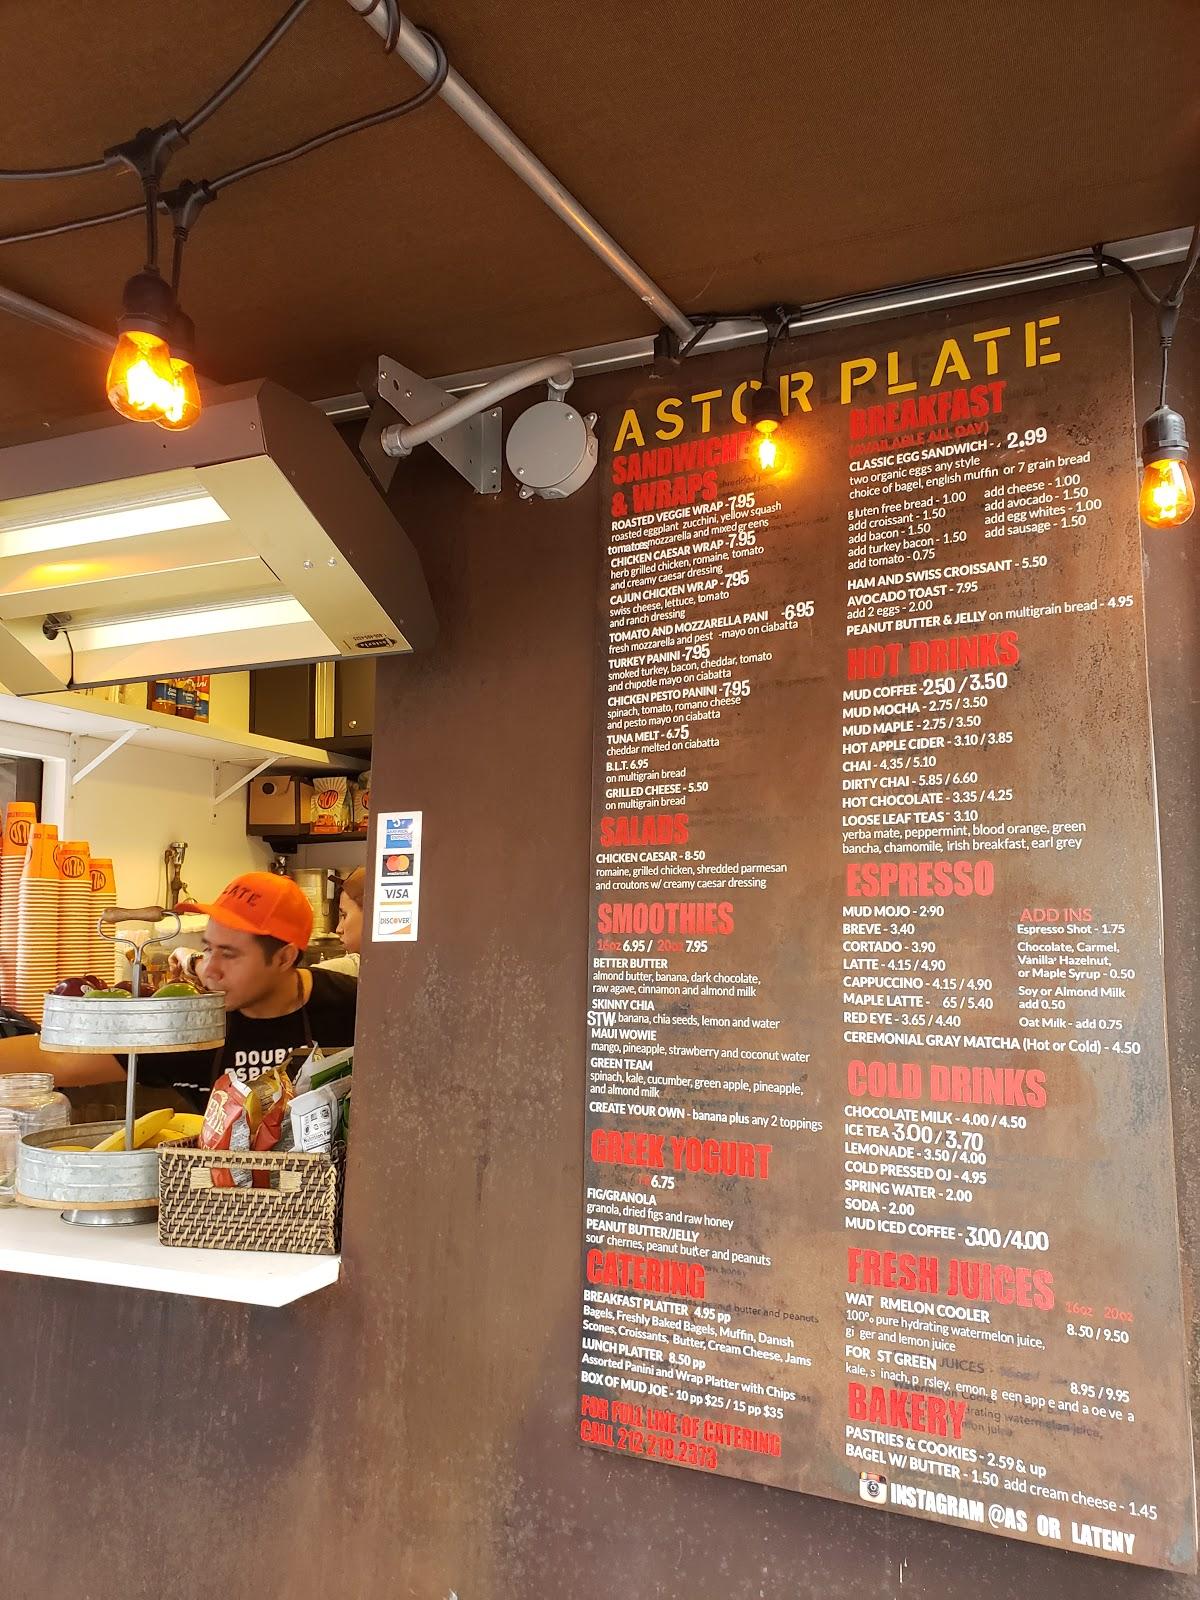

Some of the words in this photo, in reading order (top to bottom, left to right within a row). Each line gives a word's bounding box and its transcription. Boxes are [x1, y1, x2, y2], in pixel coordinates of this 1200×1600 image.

[840, 316, 1060, 404] PLATE
[850, 380, 1008, 440] BREAKFAST
[850, 455, 894, 472] CLASSIC
[896, 451, 919, 464] EGG
[921, 440, 987, 460] SANDWICH
[1007, 427, 1047, 449] 2.99
[612, 492, 627, 517] &
[633, 471, 717, 514] WRAPS
[611, 515, 654, 531] ROASTED
[656, 510, 690, 525] VEGGIE
[693, 501, 723, 516] WRAP
[611, 528, 642, 542] roasted
[644, 523, 678, 539] eggplant
[683, 515, 719, 529] zucchini,
[720, 510, 750, 524] yellow
[751, 501, 781, 517] squash
[611, 554, 652, 568] CHICKEN
[653, 546, 690, 560] CAESAR
[693, 540, 723, 553] WRAP
[848, 574, 875, 590] HAM
[878, 572, 904, 584] AND
[905, 569, 941, 582] SWISS
[944, 560, 1012, 577] CROISSANT
[1021, 556, 1047, 569] 5.50
[847, 591, 906, 607] AVOCADO
[908, 585, 946, 600] TOAST
[957, 581, 978, 593] 7.95
[847, 620, 893, 636] PEANUT
[896, 615, 941, 630] BUTTER
[943, 615, 952, 625] &
[954, 611, 987, 624] JELLY
[989, 610, 1003, 620] on
[1006, 601, 1061, 620] multigrain
[1064, 593, 1097, 612] bread
[610, 628, 650, 642] TOMATO
[651, 626, 673, 637] AND
[675, 615, 742, 633] MOZZARELLA
[608, 669, 639, 681] smoked
[641, 665, 669, 679] turkey,
[671, 661, 699, 673] bacon,
[701, 657, 738, 669] cheddar,
[740, 652, 772, 664] tomato
[609, 654, 646, 669] TURKEY
[647, 651, 680, 664] PANINI
[847, 643, 903, 681] HOT
[909, 631, 1020, 674] DRINKS
[843, 689, 871, 701] MUD
[873, 685, 917, 698] COFFEE
[607, 733, 634, 744] TUNA
[635, 730, 659, 742] MELT
[843, 743, 868, 755] HOT
[870, 740, 906, 752] APPLE
[909, 737, 944, 750] CIDER
[630, 759, 648, 769] 6.95
[606, 786, 643, 799] GRILLED
[645, 784, 681, 796] CHEESE
[688, 782, 708, 793] 5.50
[843, 778, 878, 790] DIRTY
[880, 776, 909, 788] CHAI
[843, 796, 868, 808] HOT
[870, 793, 943, 807] CHOCOLATE
[843, 815, 880, 826] LOOSE
[883, 813, 912, 825] LEAF
[914, 812, 944, 823] TEAS
[953, 810, 977, 821] 3.10
[601, 813, 689, 847] SALADS
[846, 861, 994, 897] ESPRESSO
[386, 888, 408, 898] VISA
[597, 902, 734, 935] SMOOTHIES
[1020, 908, 1059, 922] ADD
[1064, 909, 1092, 922] INS
[843, 924, 881, 935] BREVE
[1018, 924, 1064, 935] Espresso
[1067, 924, 1092, 934] Shot
[1102, 924, 1125, 934] 1.75
[623, 940, 645, 951] 6.95
[686, 940, 707, 952] 7.95
[843, 941, 902, 953] CORTADO
[594, 958, 628, 968] BETTER
[630, 959, 667, 969] BUTTER
[593, 971, 624, 980] almond
[626, 972, 654, 983] butter,
[656, 973, 689, 983] banana,
[691, 972, 711, 982] dark
[713, 973, 760, 985] chocolate,
[844, 977, 923, 989] CAPPUCCINO
[592, 999, 629, 1010] SKINNY
[630, 1000, 654, 1010] CHIA
[592, 1028, 618, 1039] MAUI
[619, 1029, 656, 1040] WOWIE
[844, 1031, 924, 1047] CEREMONIAL
[926, 1034, 961, 1047] GRAY
[963, 1036, 1020, 1050] MATCHA
[1023, 1039, 1050, 1052] (Hot
[1053, 1042, 1066, 1052] or
[1069, 1040, 1101, 1054] Cold)
[591, 1058, 623, 1069] GREEN
[624, 1059, 652, 1070] TEAM
[848, 1060, 922, 1100] COLD
[930, 1065, 1047, 1109] DRINKS
[590, 1101, 626, 1114] CREATE
[628, 1104, 656, 1117] YOUR
[659, 1108, 685, 1119] OWN
[591, 1129, 664, 1169] GREEK
[670, 1136, 772, 1179] YOGURT
[845, 1142, 914, 1159] LEMONADE
[651, 1175, 674, 1189] 6.75
[845, 1180, 889, 1195] SPRING
[892, 1184, 935, 1199] WATER
[946, 1190, 972, 1202] 2.00
[587, 1188, 656, 1205] FIG/GRANOLA
[587, 1219, 626, 1233] PEANUT
[628, 1224, 699, 1242] BUTTER/JELLY
[587, 1248, 704, 1299] CATERING
[848, 1248, 938, 1294] FRESH
[948, 1259, 1054, 1312] JUICES
[584, 1290, 642, 1308] BREAKFAST
[644, 1300, 688, 1316] PLATTER
[694, 1307, 715, 1319] 4.95
[718, 1312, 731, 1324] pp
[1067, 1324, 1093, 1339] 8.50
[1104, 1329, 1129, 1343] 9.50
[582, 1371, 603, 1385] BOX
[605, 1376, 619, 1386] OF
[621, 1379, 647, 1393] MUD
[649, 1384, 668, 1397] JOE
[850, 1382, 968, 1440] BAKERY
[581, 1420, 614, 1446] CALL
[582, 1395, 608, 1416] FOR
[612, 1401, 643, 1427] FULL
[648, 1409, 676, 1434] LINE
[681, 1415, 699, 1439] OF
[704, 1420, 781, 1457] CATERING
[846, 1425, 904, 1448] PASTRIES
[906, 1437, 915, 1450] &
[918, 1440, 977, 1462] COOKIES
[846, 1444, 886, 1465] BAGEL
[910, 1458, 960, 1479] BUTTER
[891, 1483, 984, 1523] INSTAGRAM
